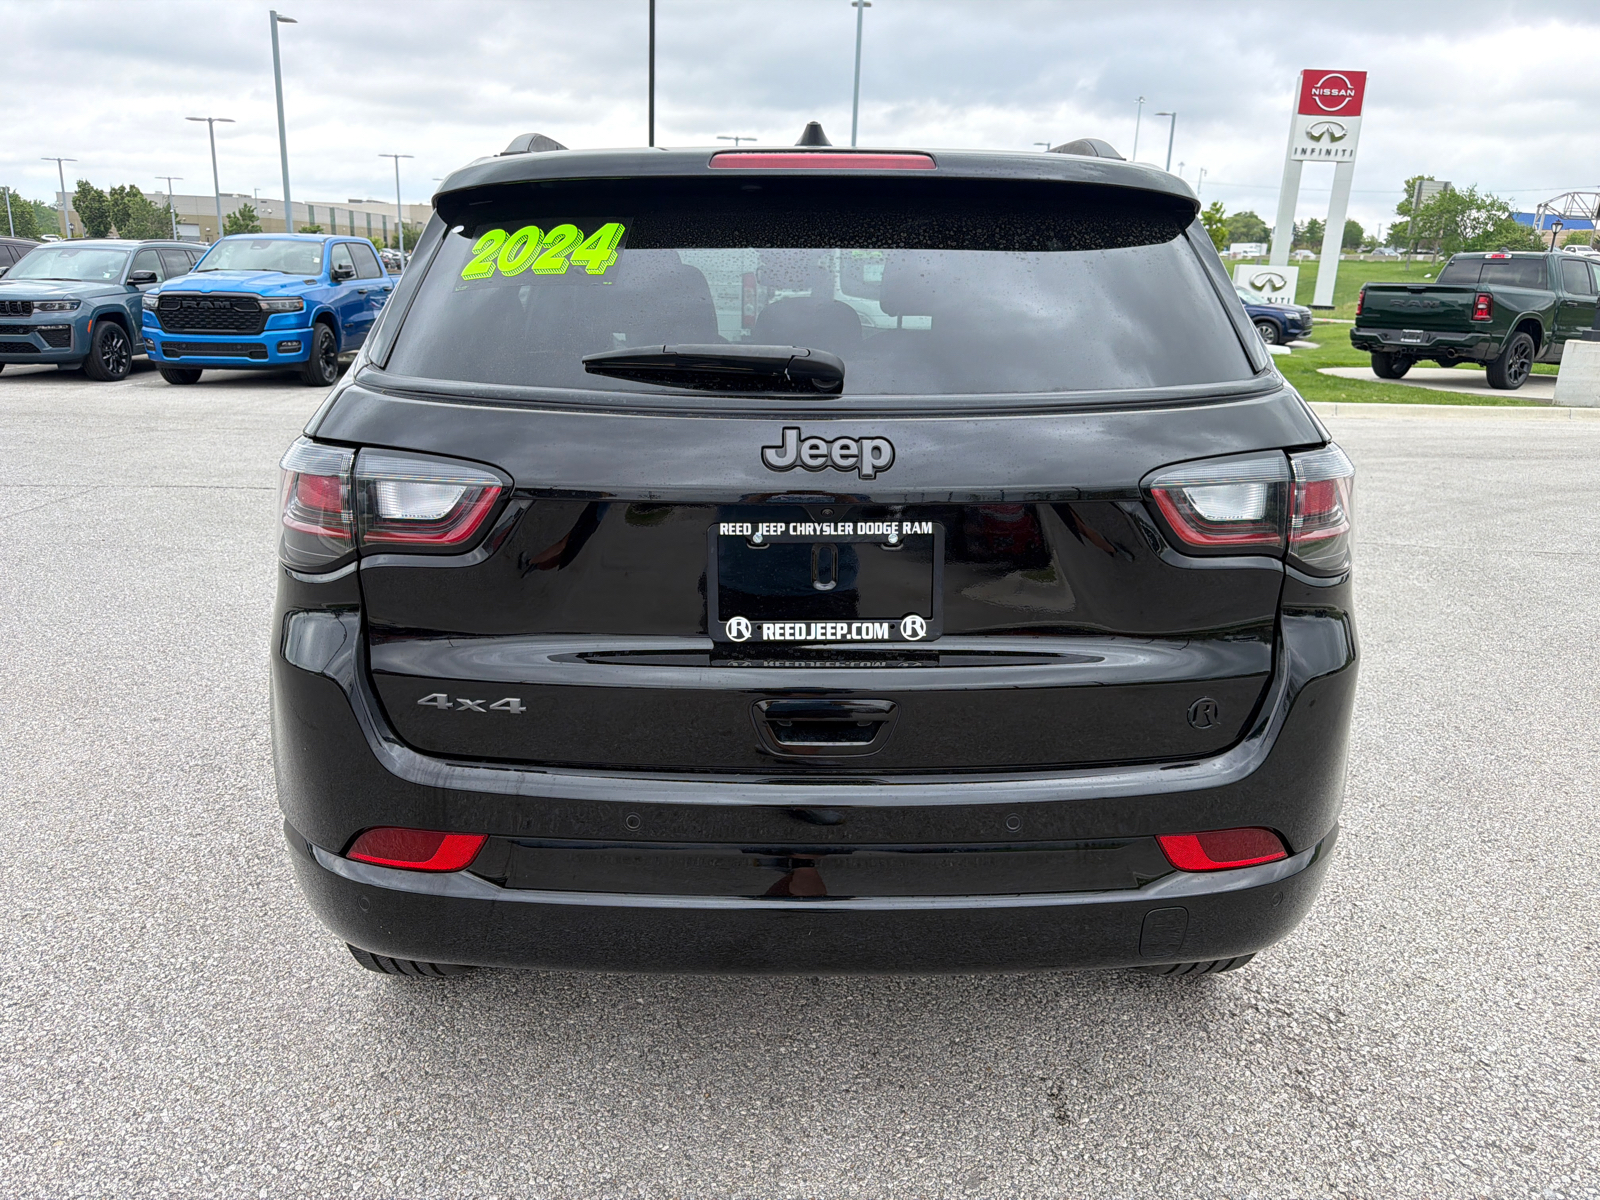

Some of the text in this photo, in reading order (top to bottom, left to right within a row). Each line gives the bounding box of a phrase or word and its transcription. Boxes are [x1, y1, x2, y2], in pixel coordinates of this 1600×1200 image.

[1311, 88, 1355, 97] NISSAN
[1294, 147, 1353, 157] INFINITI
[461, 222, 626, 281] 2024
[182, 300, 231, 309] RAM
[1390, 299, 1440, 309] RAM
[762, 427, 895, 479] Jeep
[719, 521, 933, 536] REED JEEP CHRYSLER DODGE RAM
[762, 622, 889, 640] REEDJEEP.COM
[417, 693, 527, 714] 4x4
